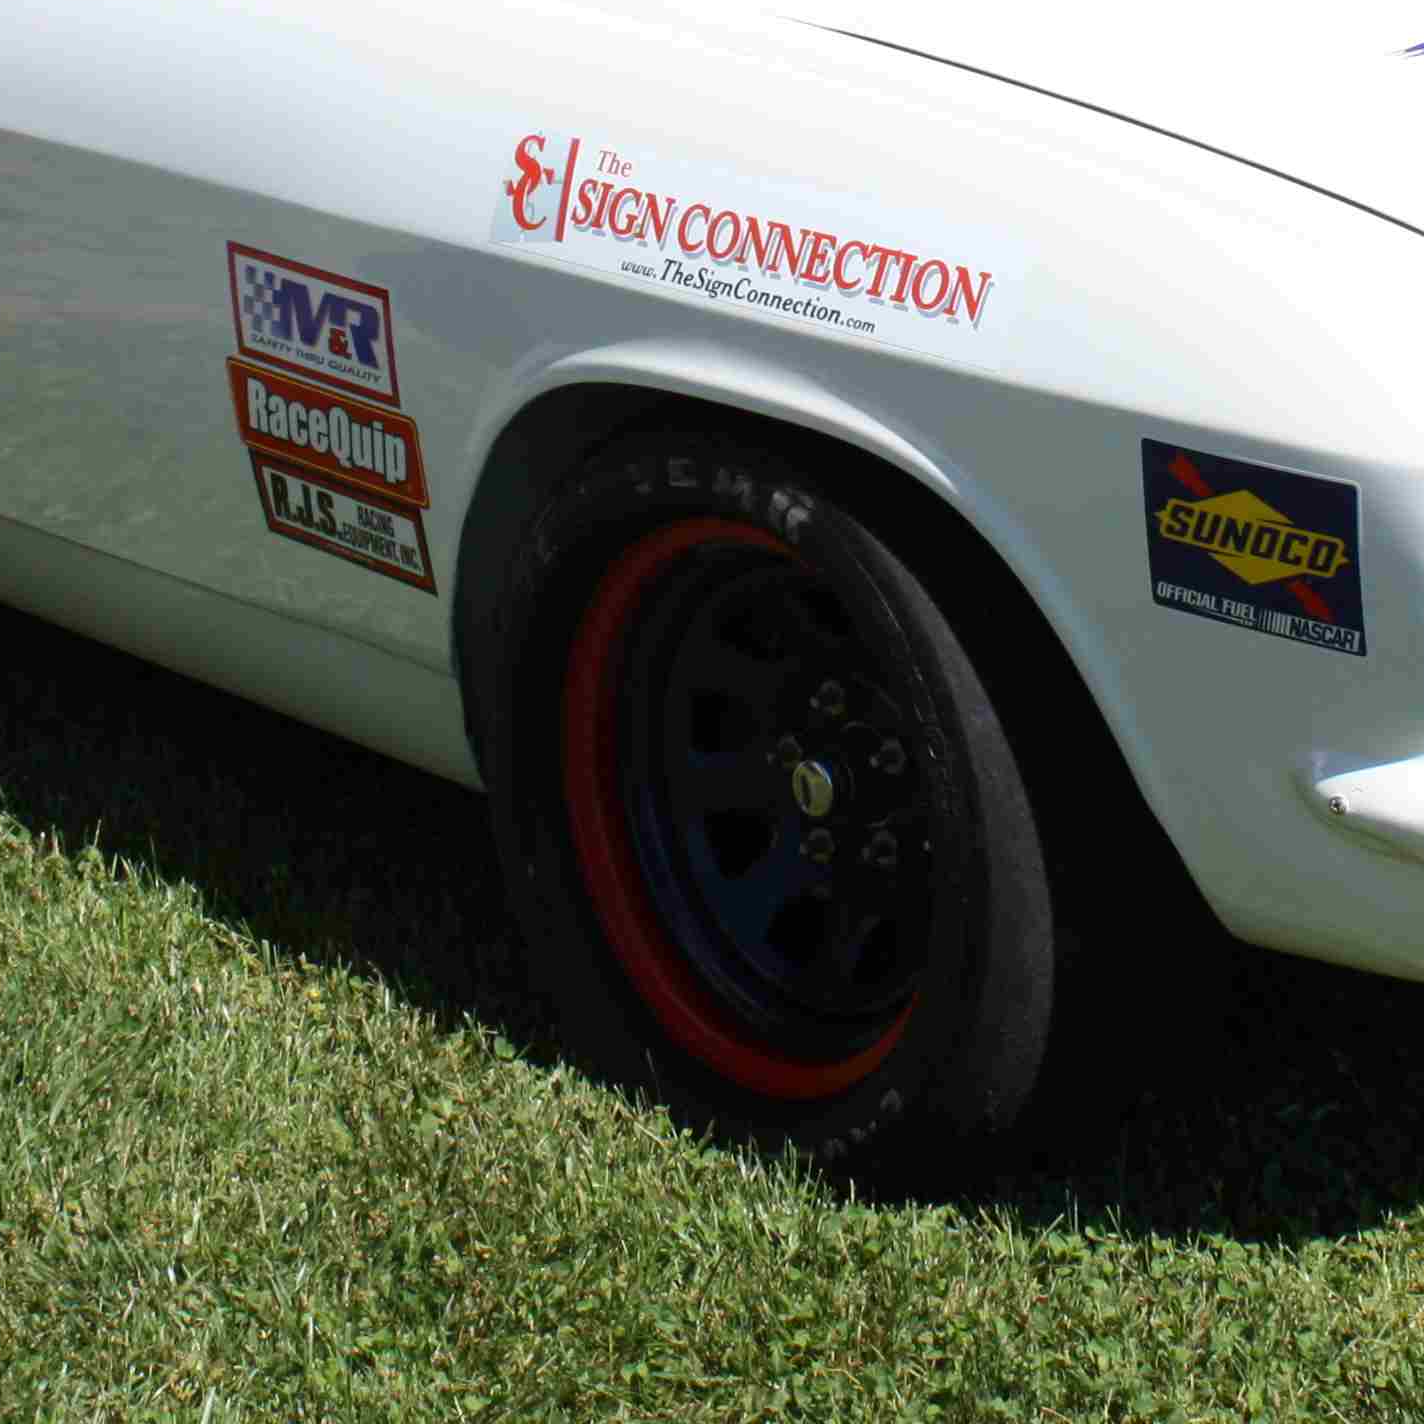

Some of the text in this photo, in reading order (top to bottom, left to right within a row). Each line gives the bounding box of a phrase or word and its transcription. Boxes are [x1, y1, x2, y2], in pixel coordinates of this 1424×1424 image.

[596, 149, 632, 178] The
[572, 179, 992, 322] SIGN CONNECTION
[327, 360, 382, 383] QUALITY
[247, 376, 407, 485] RaceQuip
[357, 505, 395, 537] RACING
[1164, 504, 1339, 572] SUNOCO
[1156, 581, 1355, 650] OFFICIAL FUEL NASCAR
